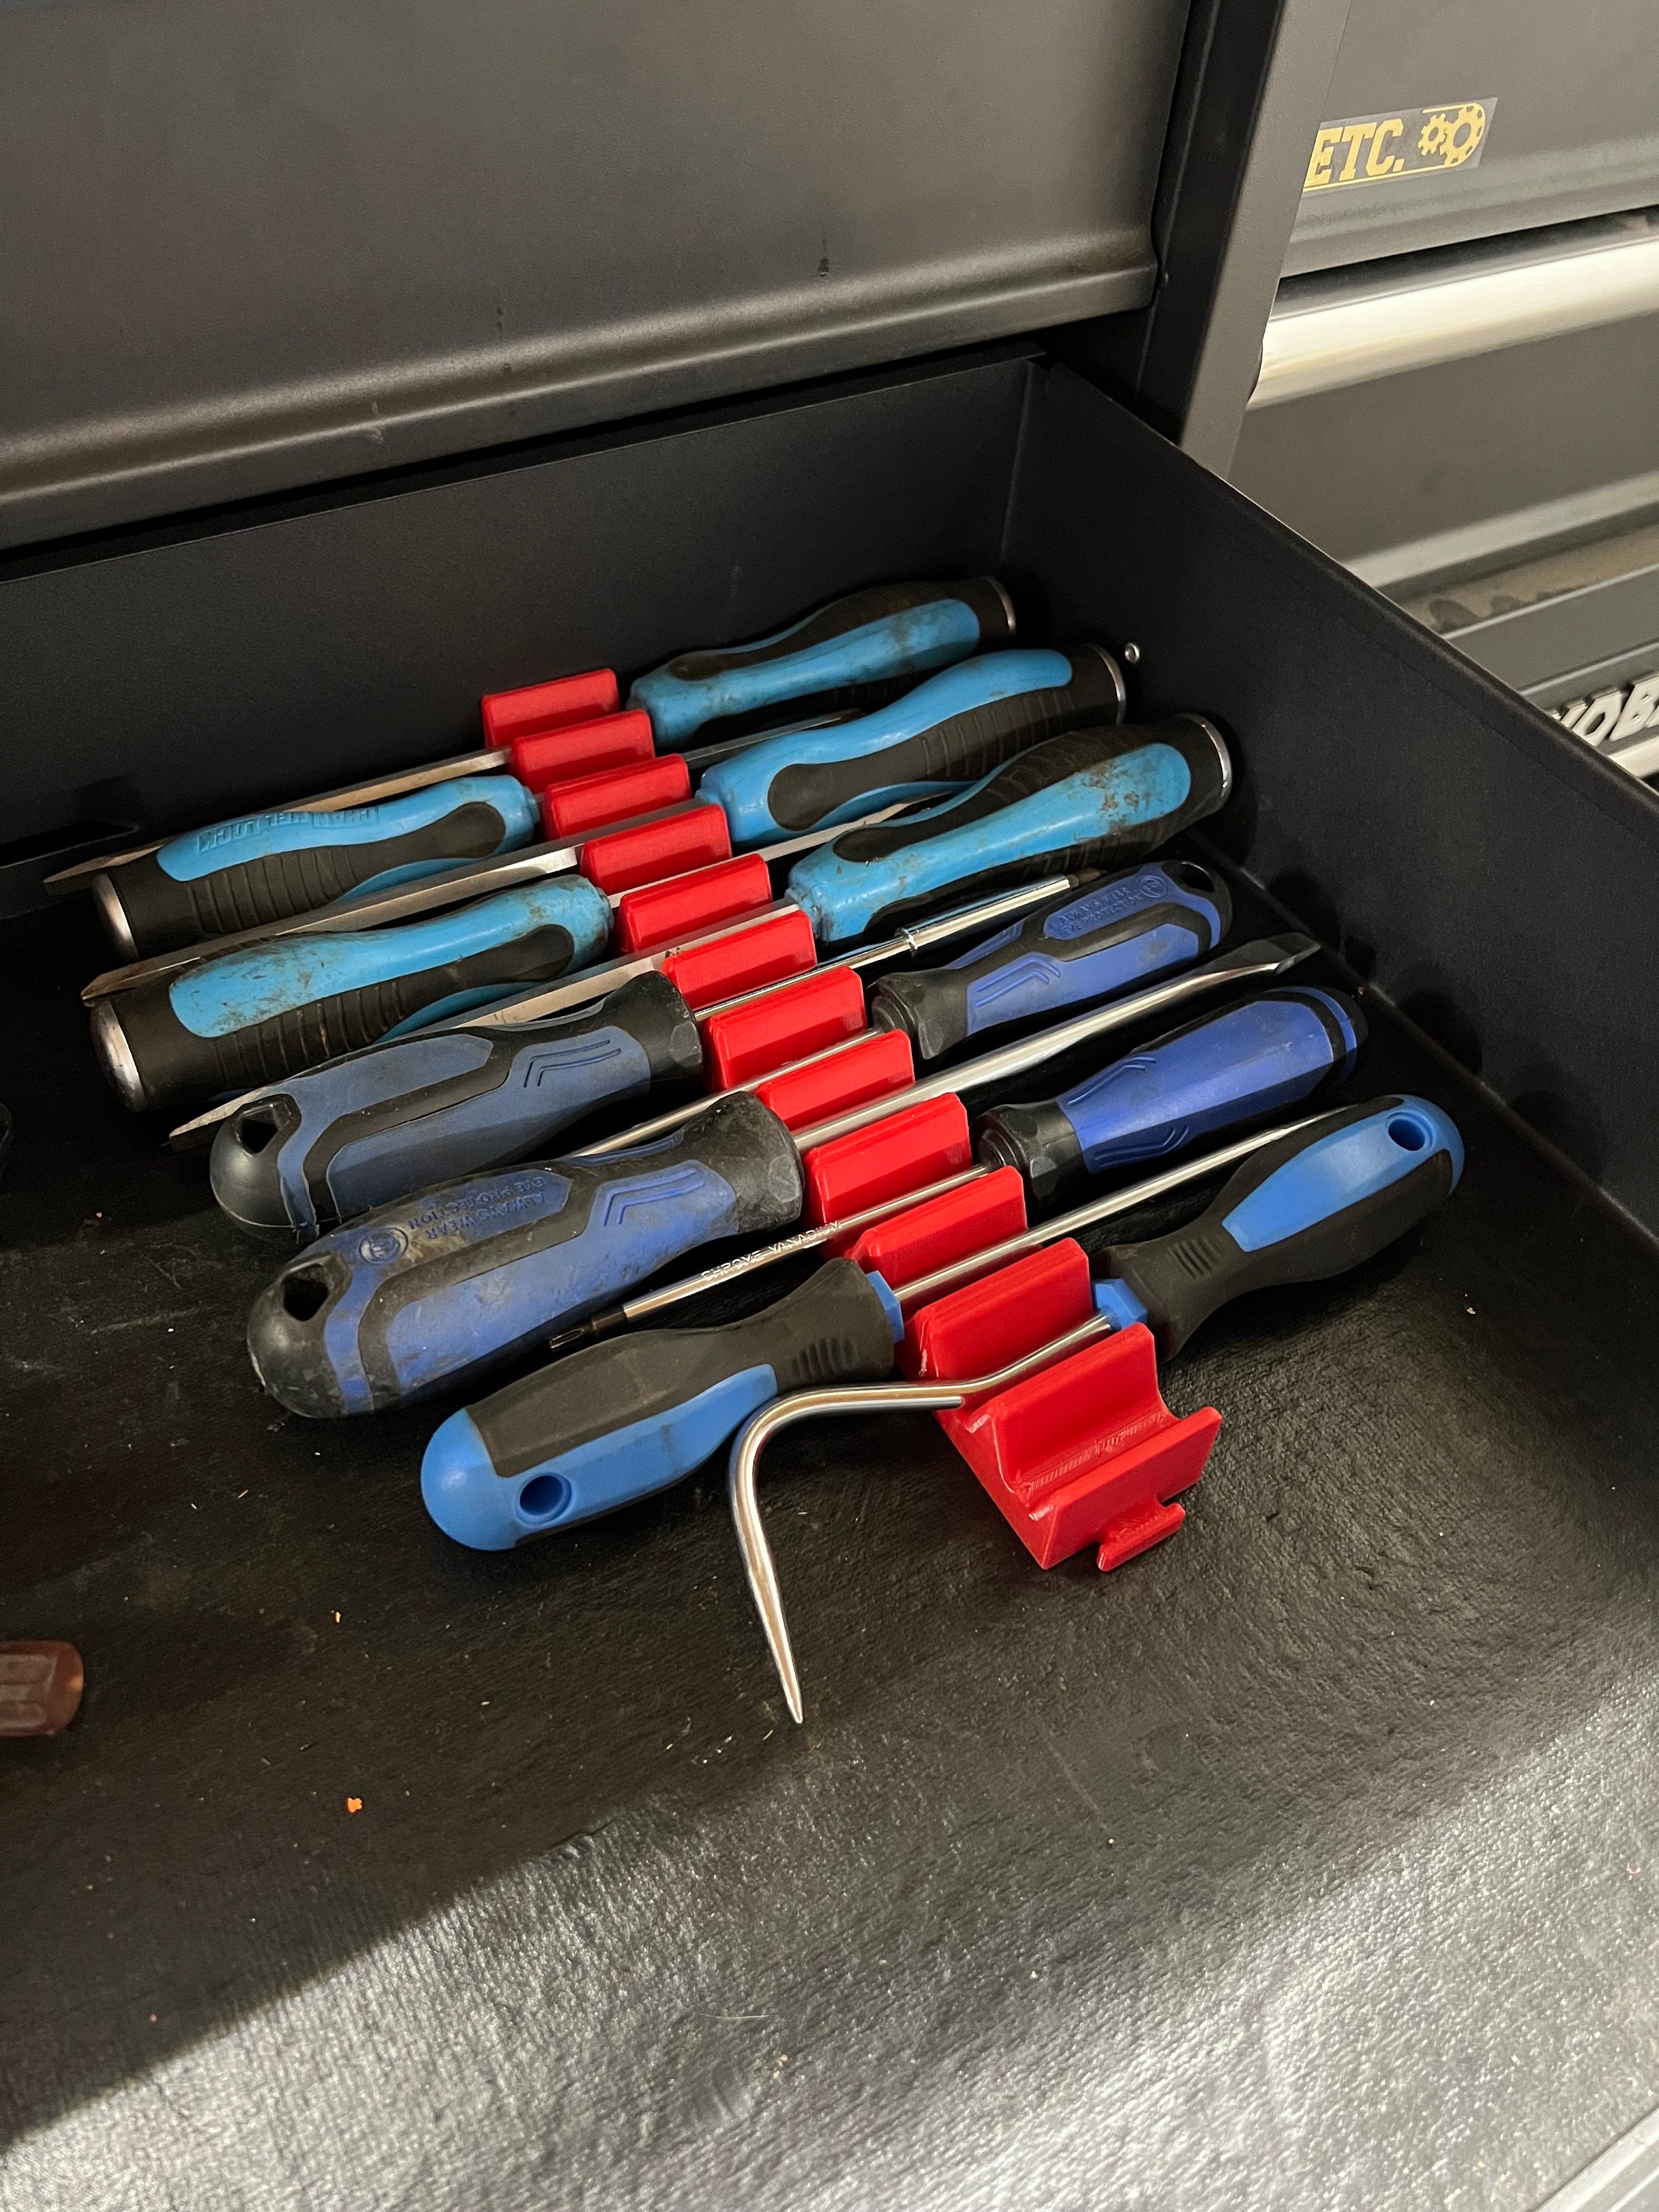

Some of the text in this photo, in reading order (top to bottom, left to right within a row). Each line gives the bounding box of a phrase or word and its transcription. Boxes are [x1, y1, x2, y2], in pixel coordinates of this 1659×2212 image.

[1306, 119, 1405, 187] ETC.
[408, 1186, 513, 1230] PROTECTION
[425, 1192, 546, 1240] ALWAYS WEAR
